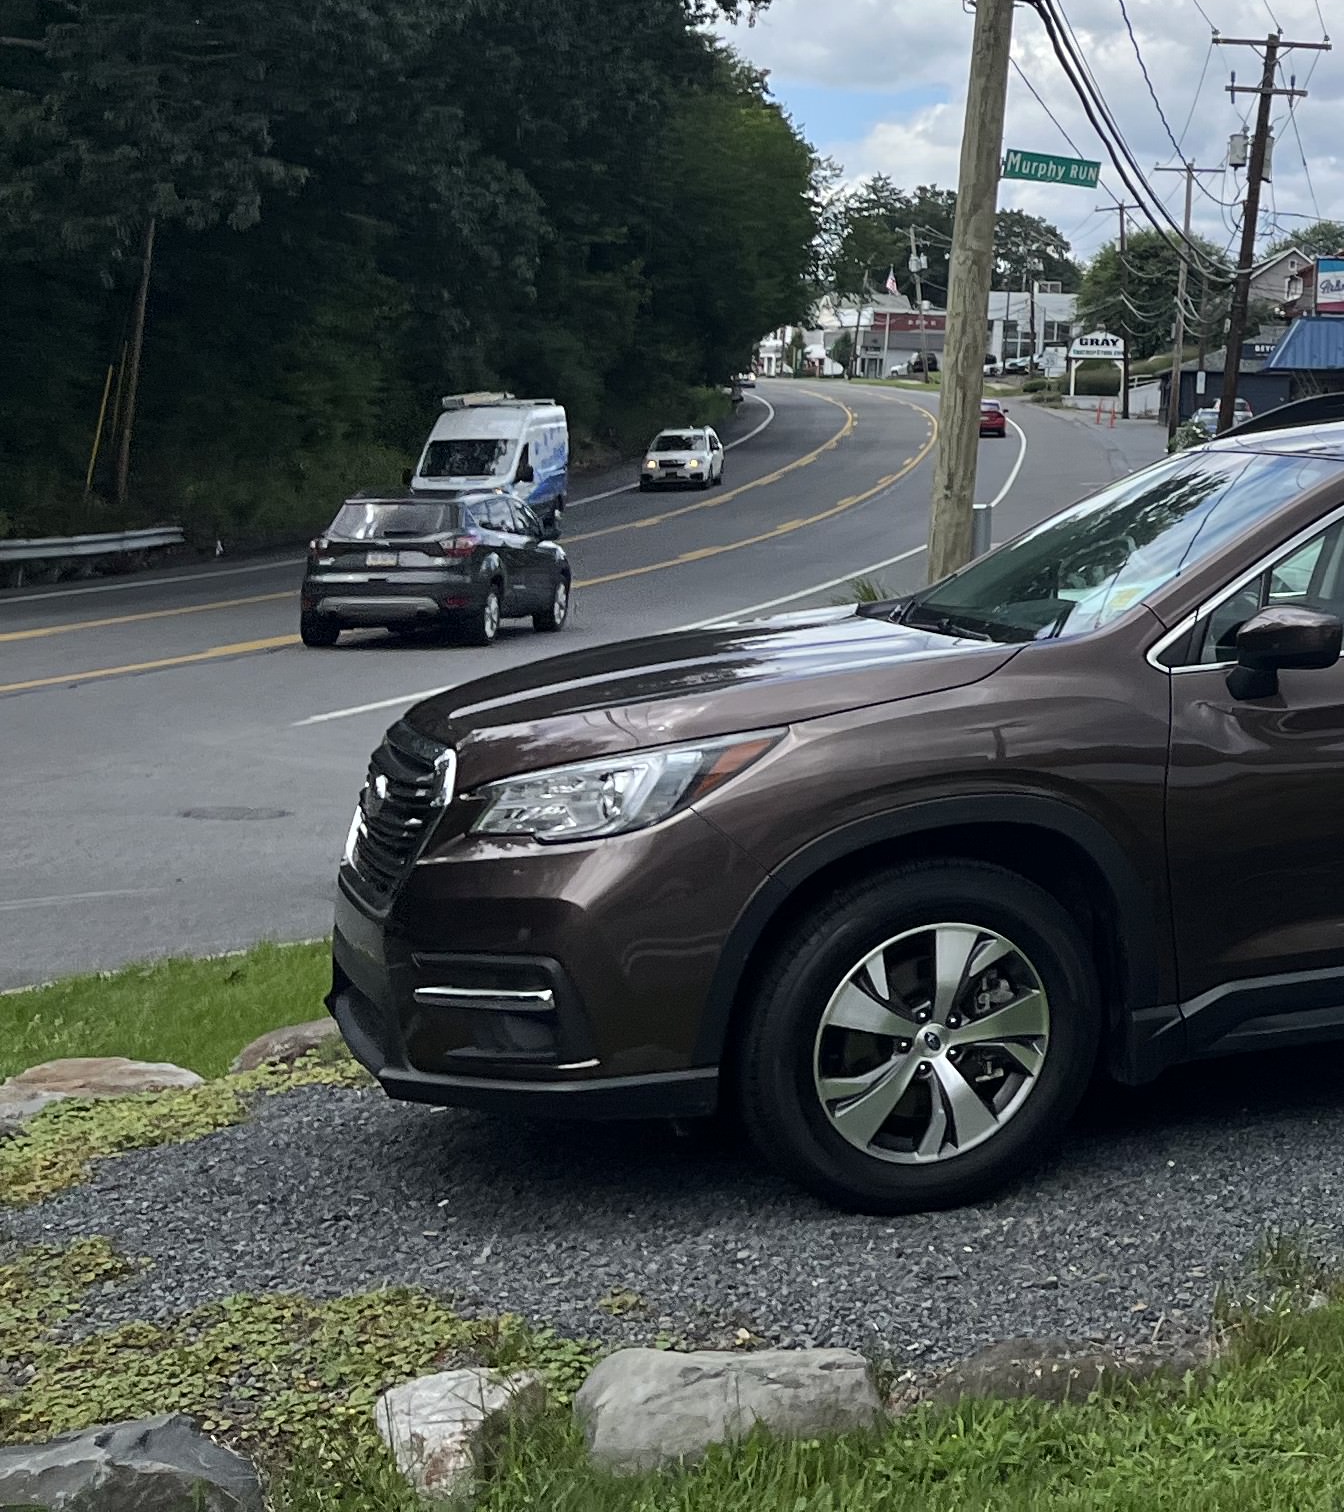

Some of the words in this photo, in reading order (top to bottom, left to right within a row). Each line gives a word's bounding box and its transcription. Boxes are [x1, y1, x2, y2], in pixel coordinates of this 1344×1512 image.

[1007, 151, 1066, 180] Murphy
[1069, 164, 1098, 182] RUN
[1079, 338, 1120, 346] GRAY
